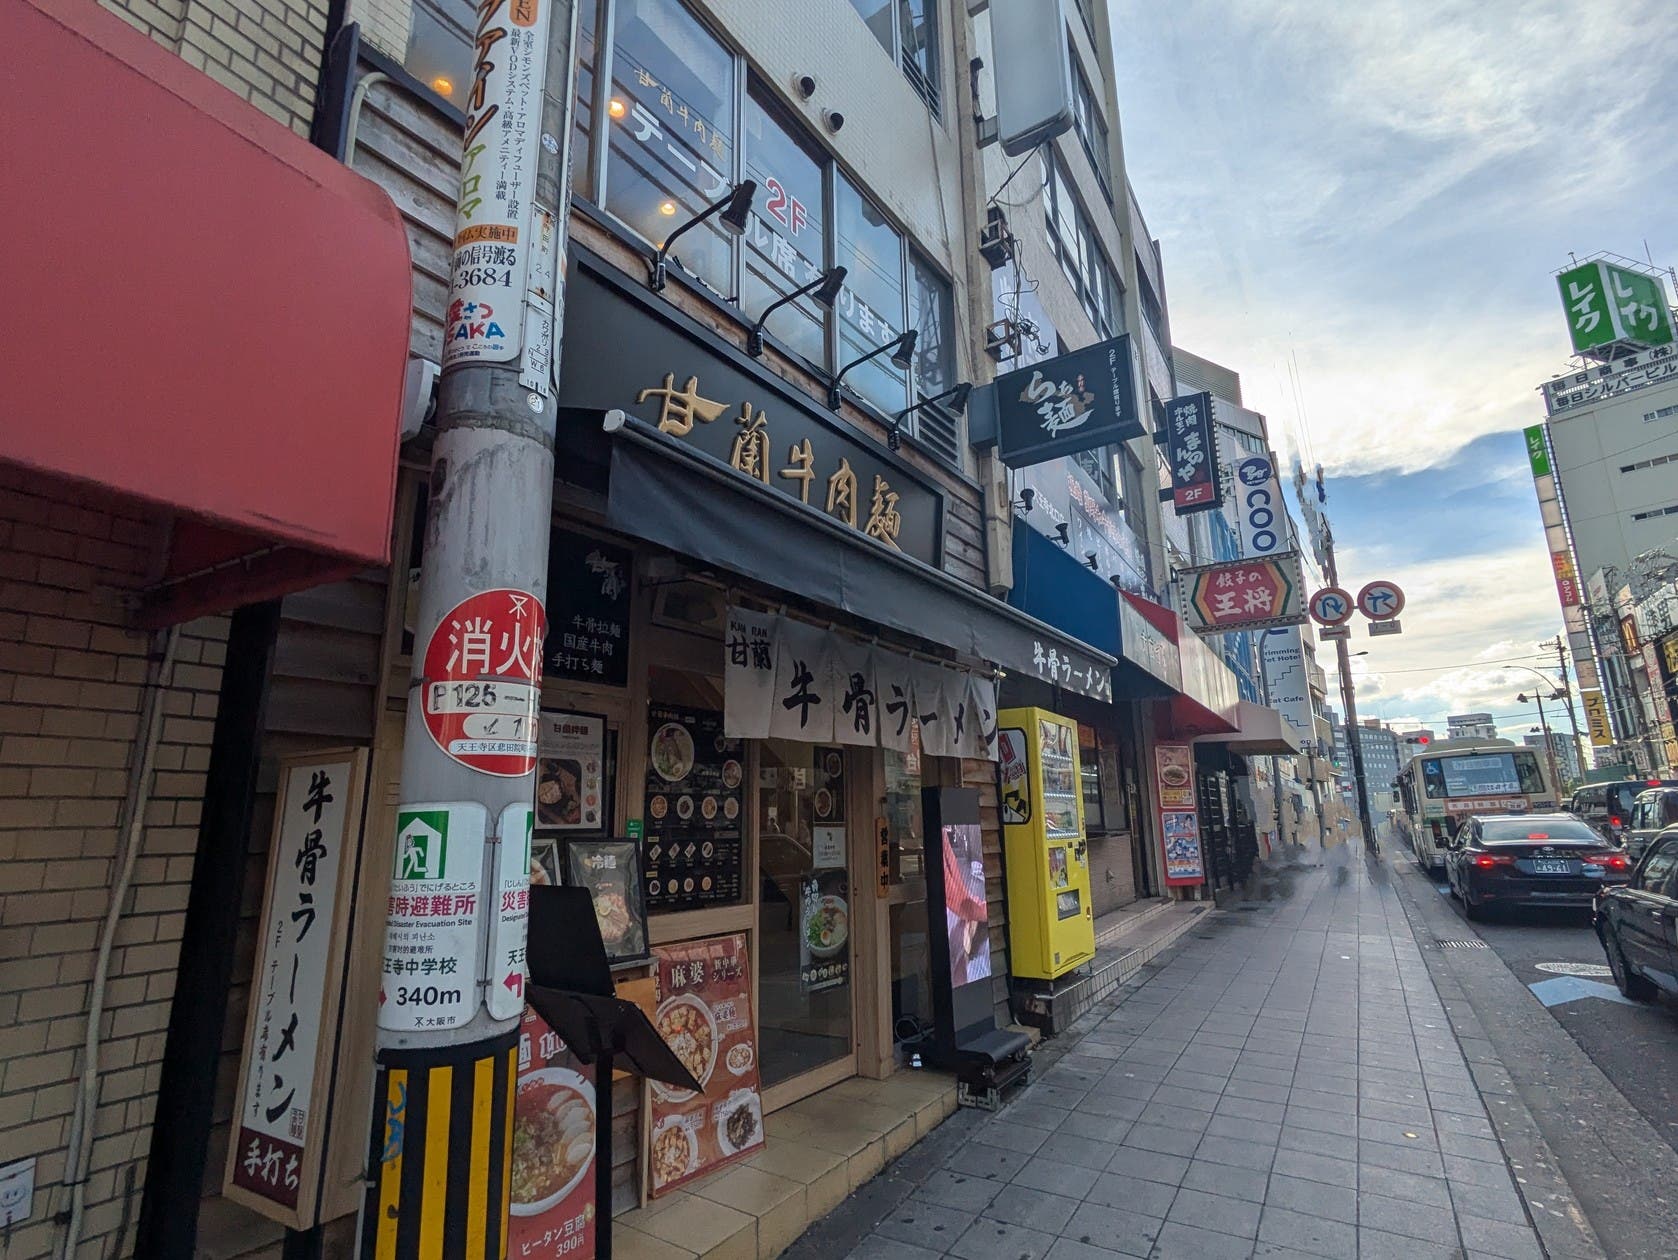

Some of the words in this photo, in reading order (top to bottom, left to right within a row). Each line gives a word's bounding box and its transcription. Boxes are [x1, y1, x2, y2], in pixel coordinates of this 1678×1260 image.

[459, 144, 487, 219] アロマ
[766, 177, 807, 236] 2F
[1569, 282, 1600, 333] レイク
[1612, 271, 1658, 331] レイク
[1109, 349, 1116, 366] 2F
[1556, 363, 1677, 407] 毎日シルバービル
[1183, 403, 1198, 427] 焼肉
[1185, 489, 1203, 501] 2F
[1247, 489, 1276, 551] COO
[1216, 570, 1262, 587] 餃子の
[1213, 587, 1272, 617] 王将
[563, 633, 613, 656] 国産牛肉
[751, 627, 768, 637] RAN
[1032, 641, 1106, 692] 牛骨ラーメン
[783, 659, 998, 746] 牛骨ラーメン
[1587, 698, 1606, 738] プロミス
[416, 920, 456, 928] Evacuation
[458, 918, 473, 926] Site
[267, 770, 333, 1123] 牛骨ラーメン
[671, 961, 704, 988] 麻婆
[713, 966, 743, 981] シリーズ
[396, 986, 461, 1006] 340m
[427, 1016, 456, 1026] 大阪市
[243, 1138, 298, 1191] 手打ち
